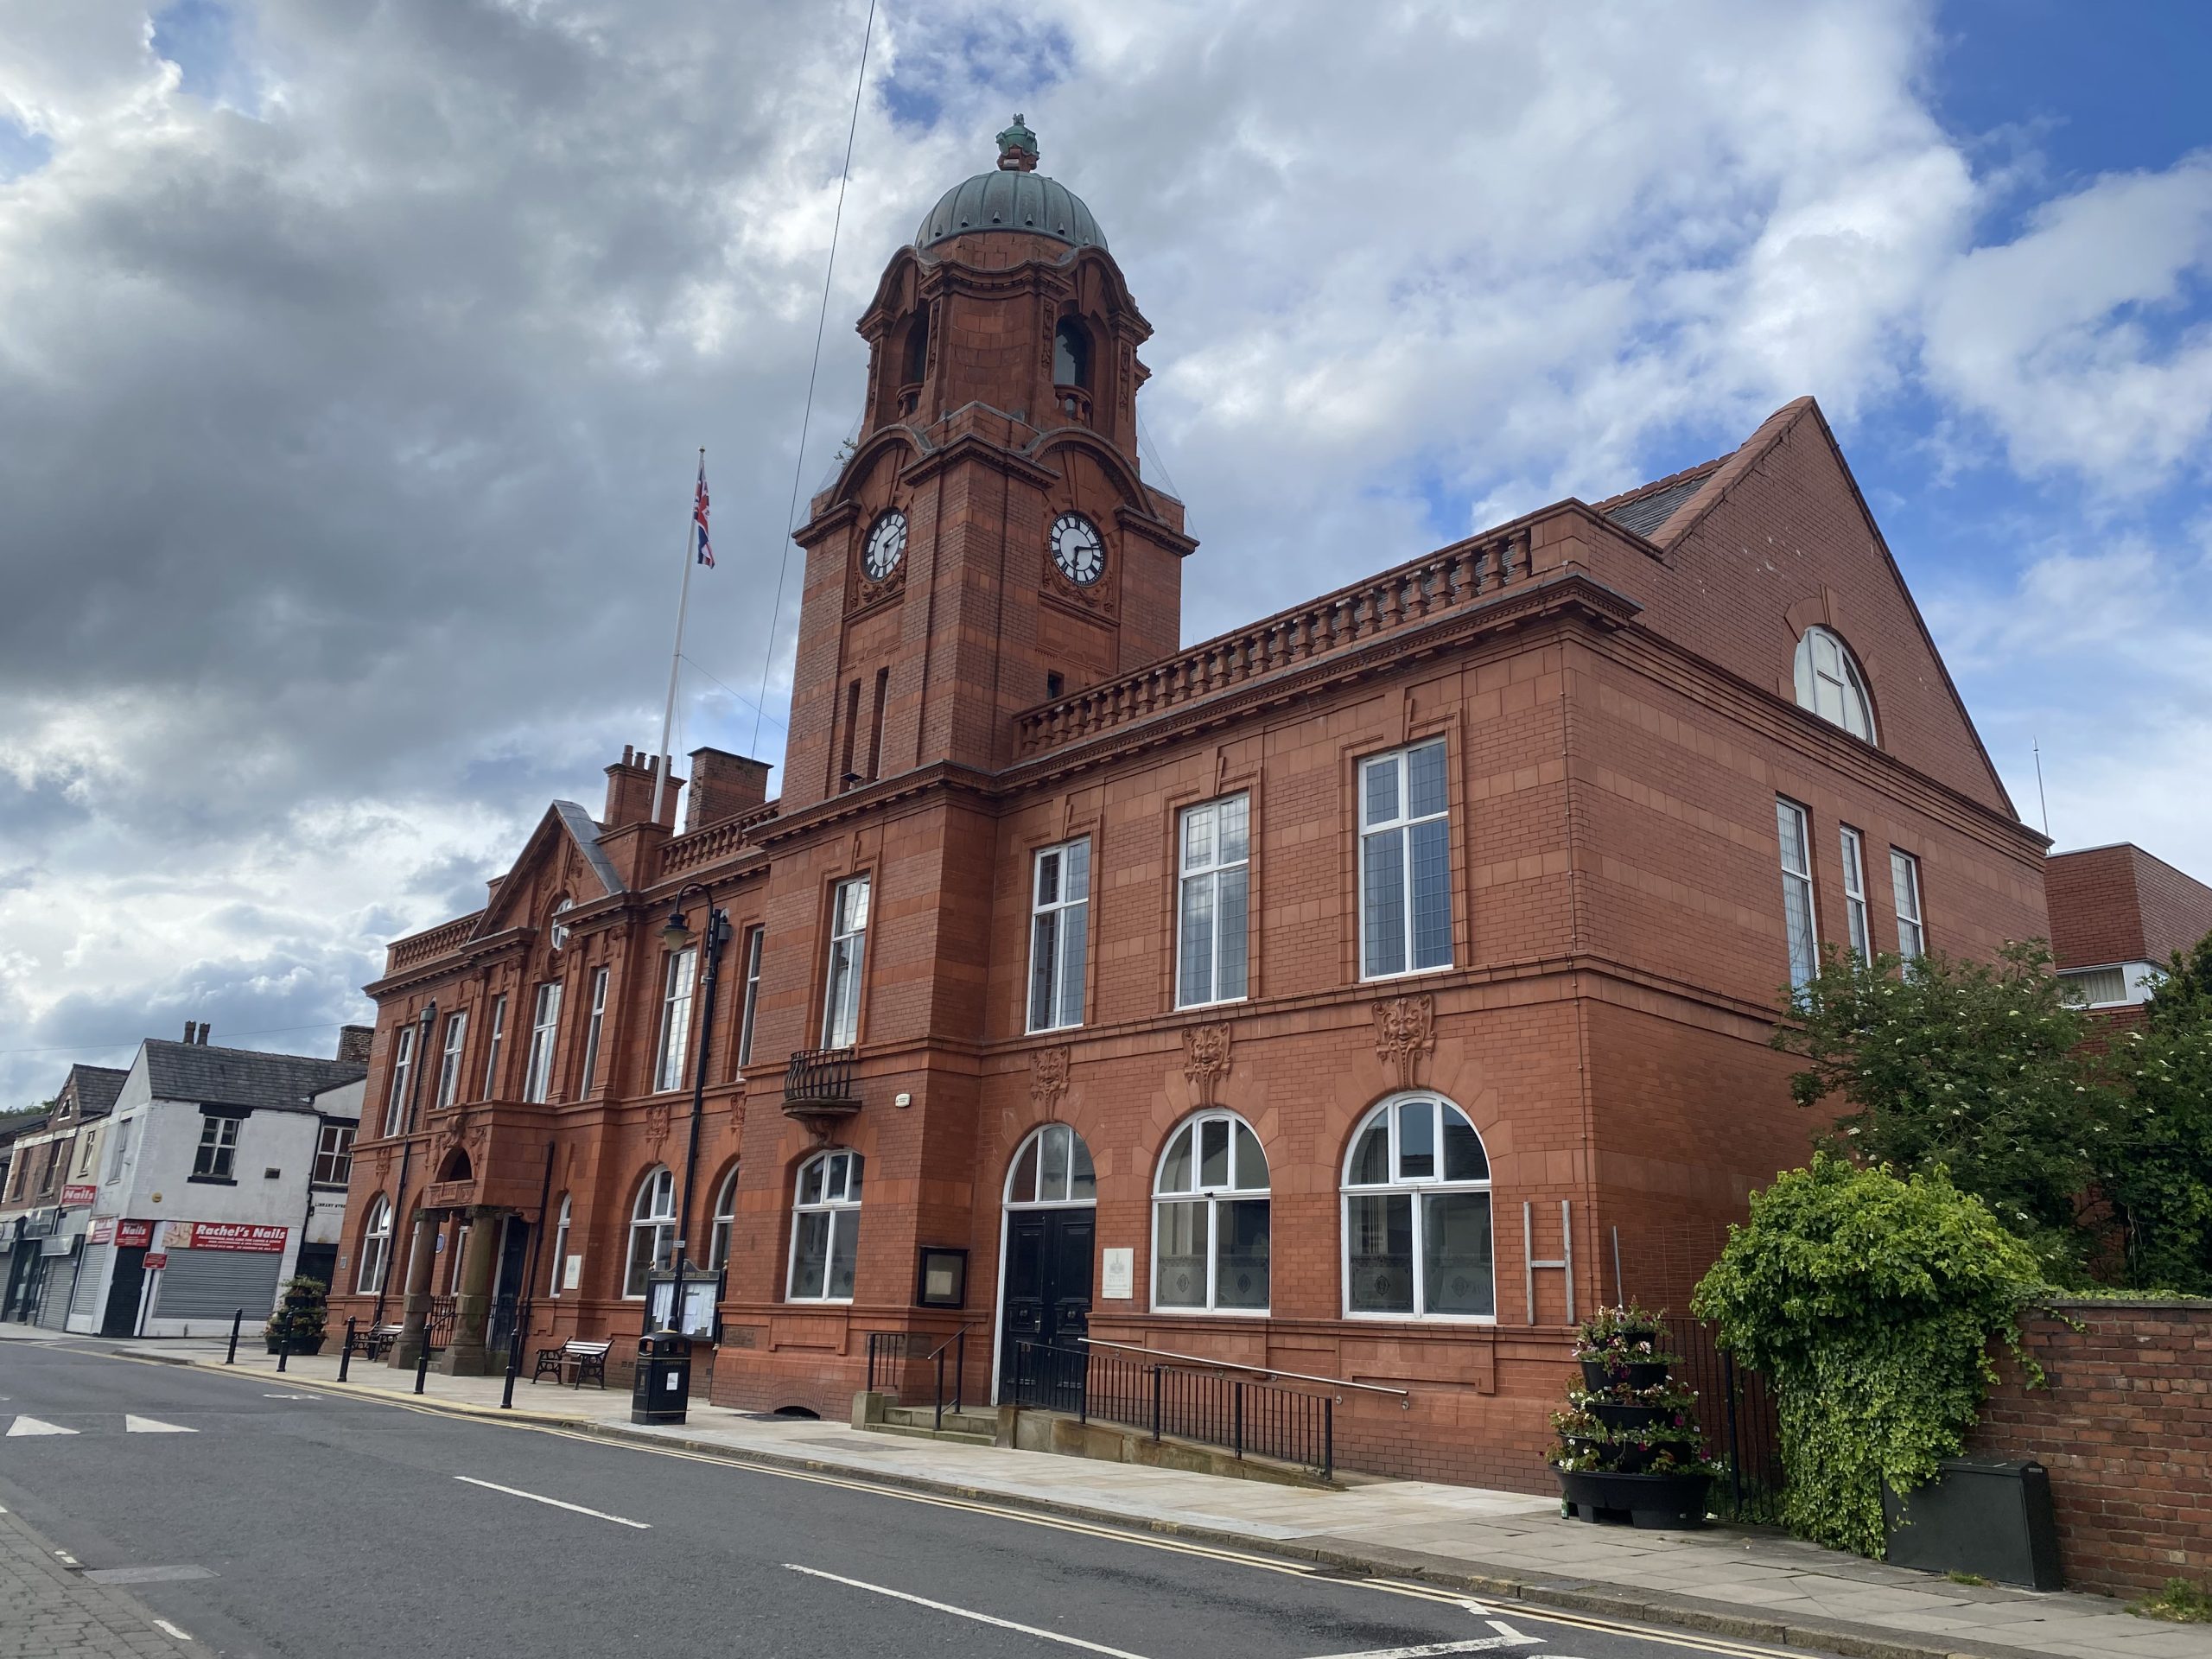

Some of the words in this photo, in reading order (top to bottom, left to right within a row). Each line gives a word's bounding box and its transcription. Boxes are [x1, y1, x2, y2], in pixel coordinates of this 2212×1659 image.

[64, 1189, 94, 1199] Nails
[122, 1225, 146, 1235] Nails
[196, 1224, 250, 1237] Rachel's
[252, 1228, 286, 1239] Nails
